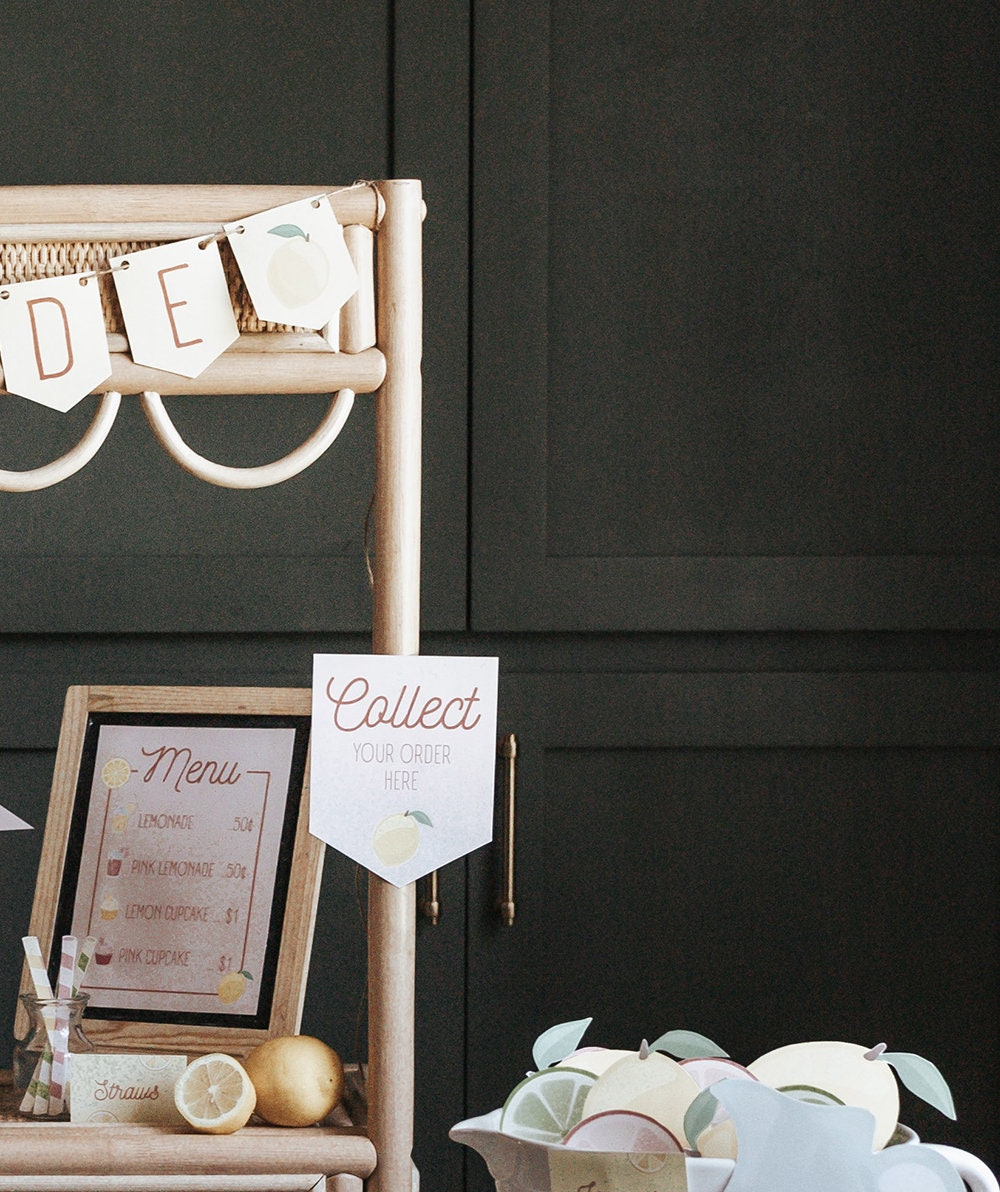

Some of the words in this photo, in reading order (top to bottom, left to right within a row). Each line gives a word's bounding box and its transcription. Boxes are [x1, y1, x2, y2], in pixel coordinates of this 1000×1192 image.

[326, 677, 482, 732] Collect
[353, 742, 394, 764] YOUR
[399, 743, 451, 765] ORDER
[141, 745, 243, 793] Menu
[384, 770, 420, 791] HERE
[137, 813, 195, 830] LEMONADE
[131, 859, 156, 876] PINK
[158, 860, 216, 878] LEMONADE
[125, 904, 162, 920] LEMON
[164, 905, 209, 922] CUPCAKE
[225, 907, 239, 924] $1
[118, 948, 144, 964] PINK
[145, 949, 191, 967] CUPCAKE
[218, 955, 232, 972] $1
[94, 1079, 160, 1101] Straws
